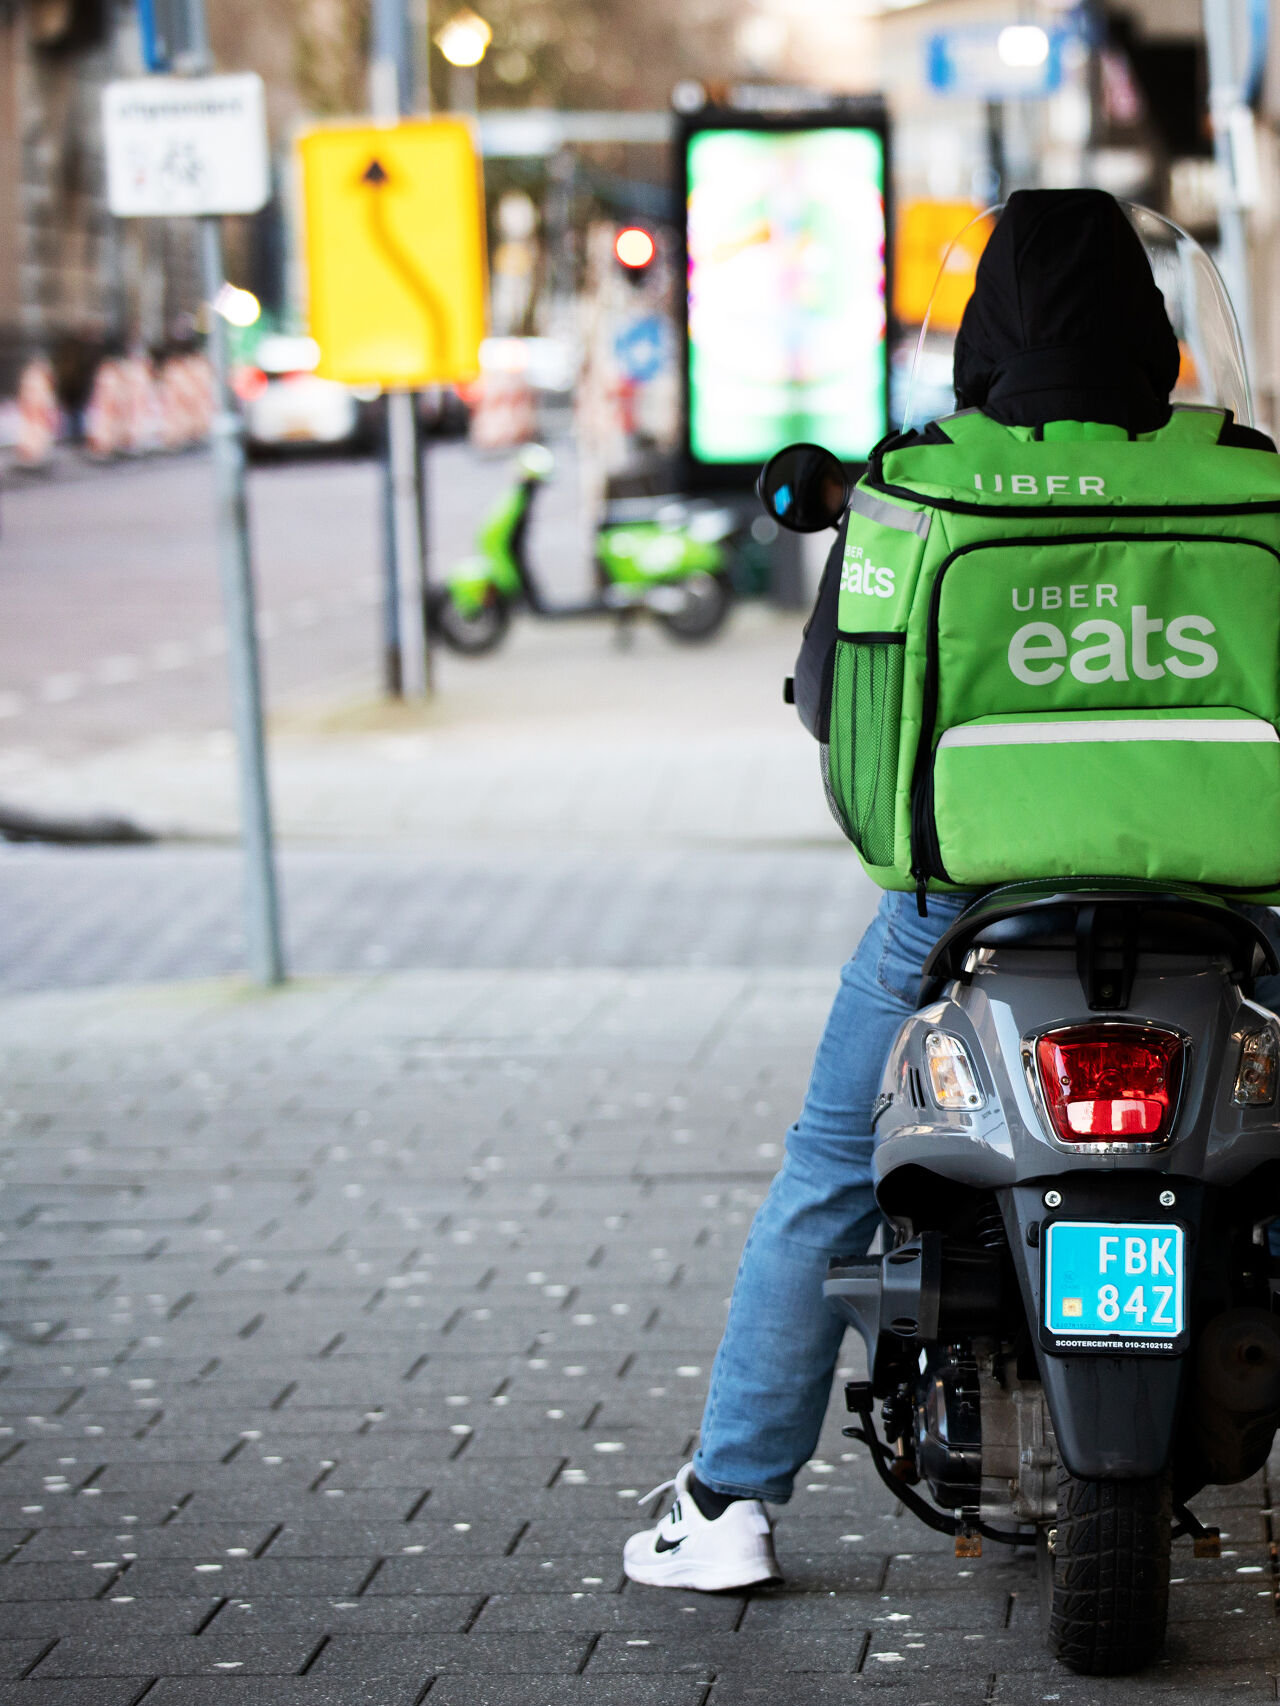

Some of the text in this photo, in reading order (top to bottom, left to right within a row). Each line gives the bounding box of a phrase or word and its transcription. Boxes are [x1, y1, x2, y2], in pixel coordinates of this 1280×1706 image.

[973, 474, 1106, 496] UBER
[845, 544, 863, 559] BER
[1012, 584, 1118, 611] UBER
[1007, 605, 1219, 686] eats
[1099, 1236, 1175, 1276] FBK
[1097, 1284, 1174, 1326] 84Z
[1055, 1340, 1173, 1349] SCOOTERCENTER 010-2102152
